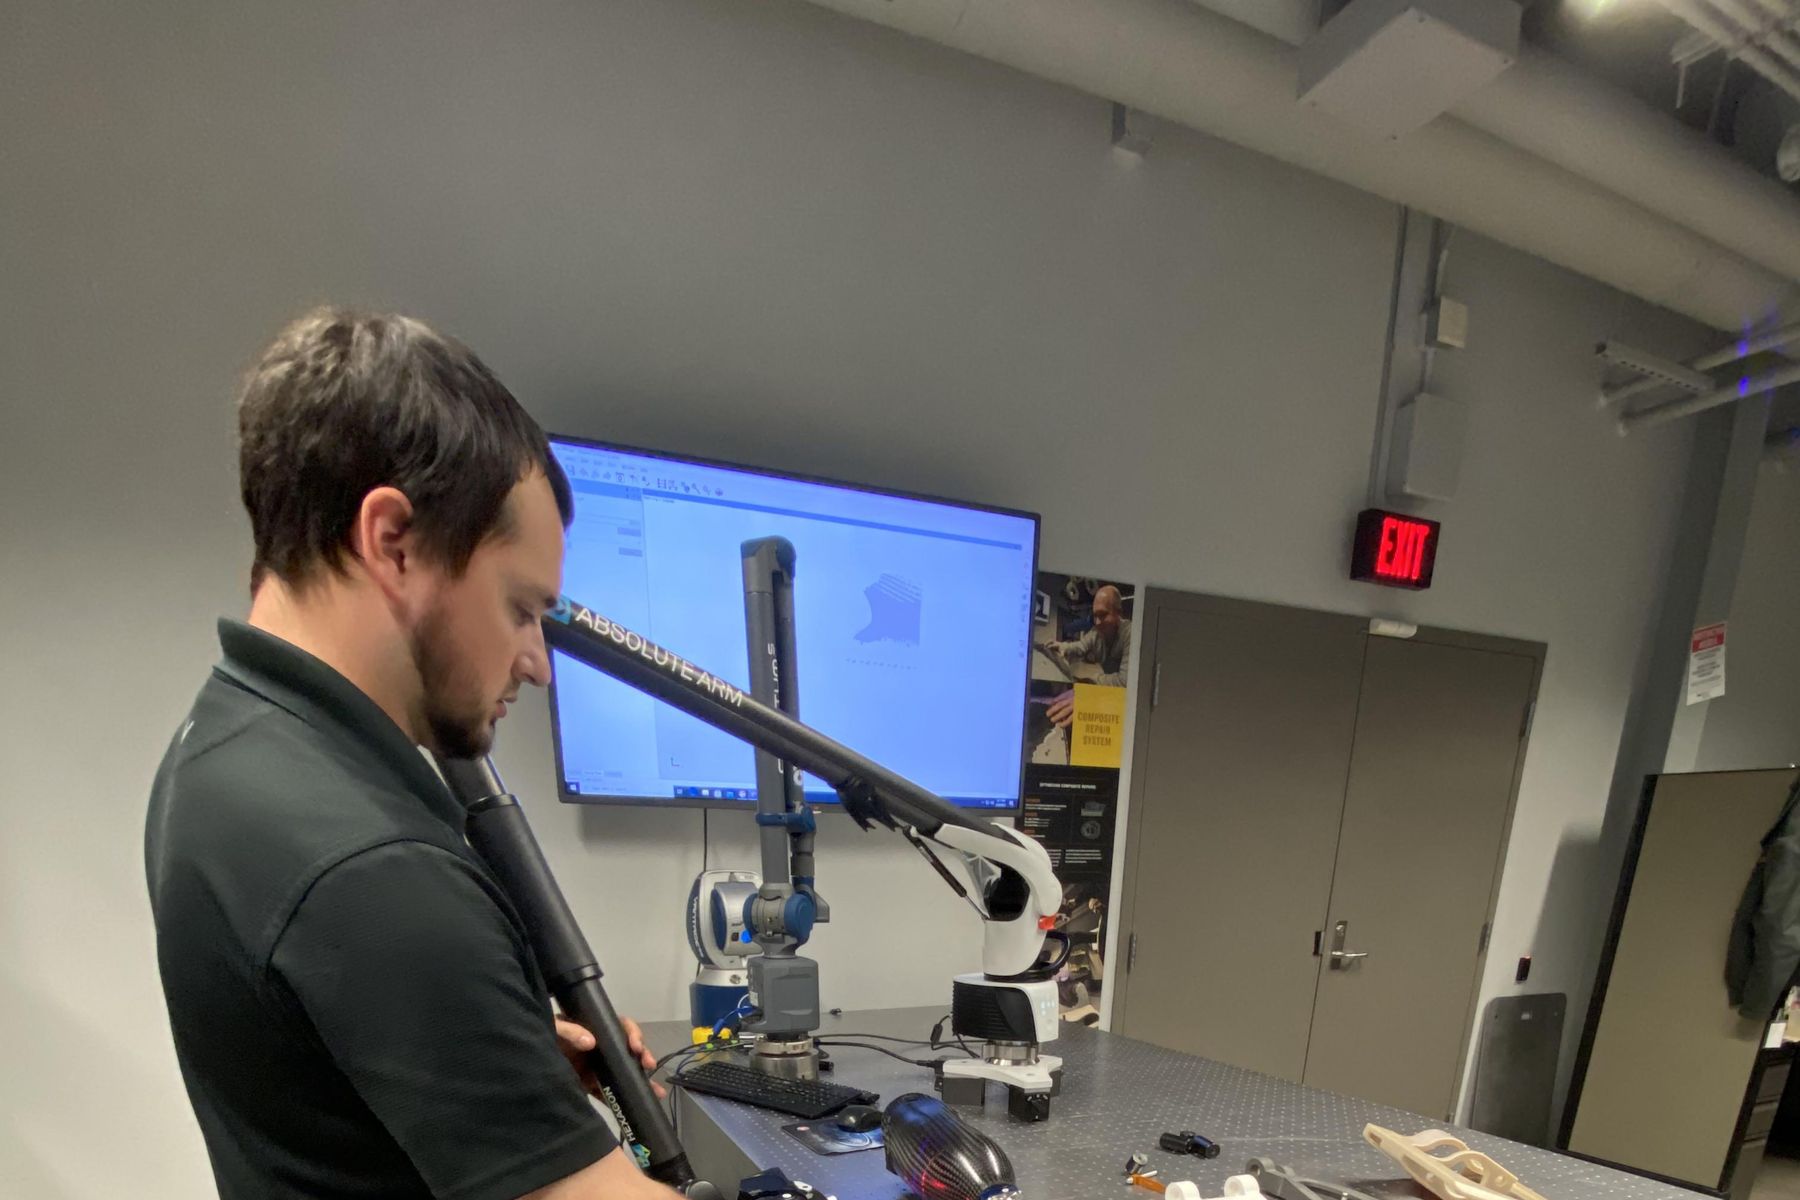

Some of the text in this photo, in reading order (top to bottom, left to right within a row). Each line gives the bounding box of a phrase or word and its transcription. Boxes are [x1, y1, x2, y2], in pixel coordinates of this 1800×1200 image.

[1376, 516, 1431, 580] EXIT
[575, 607, 744, 708] ABSOLUTE ARM
[1077, 711, 1121, 725] COMPOSITE
[1085, 723, 1111, 735] REPAIR
[1082, 735, 1112, 747] SYSTEM
[603, 1086, 636, 1142] HEXAGON
